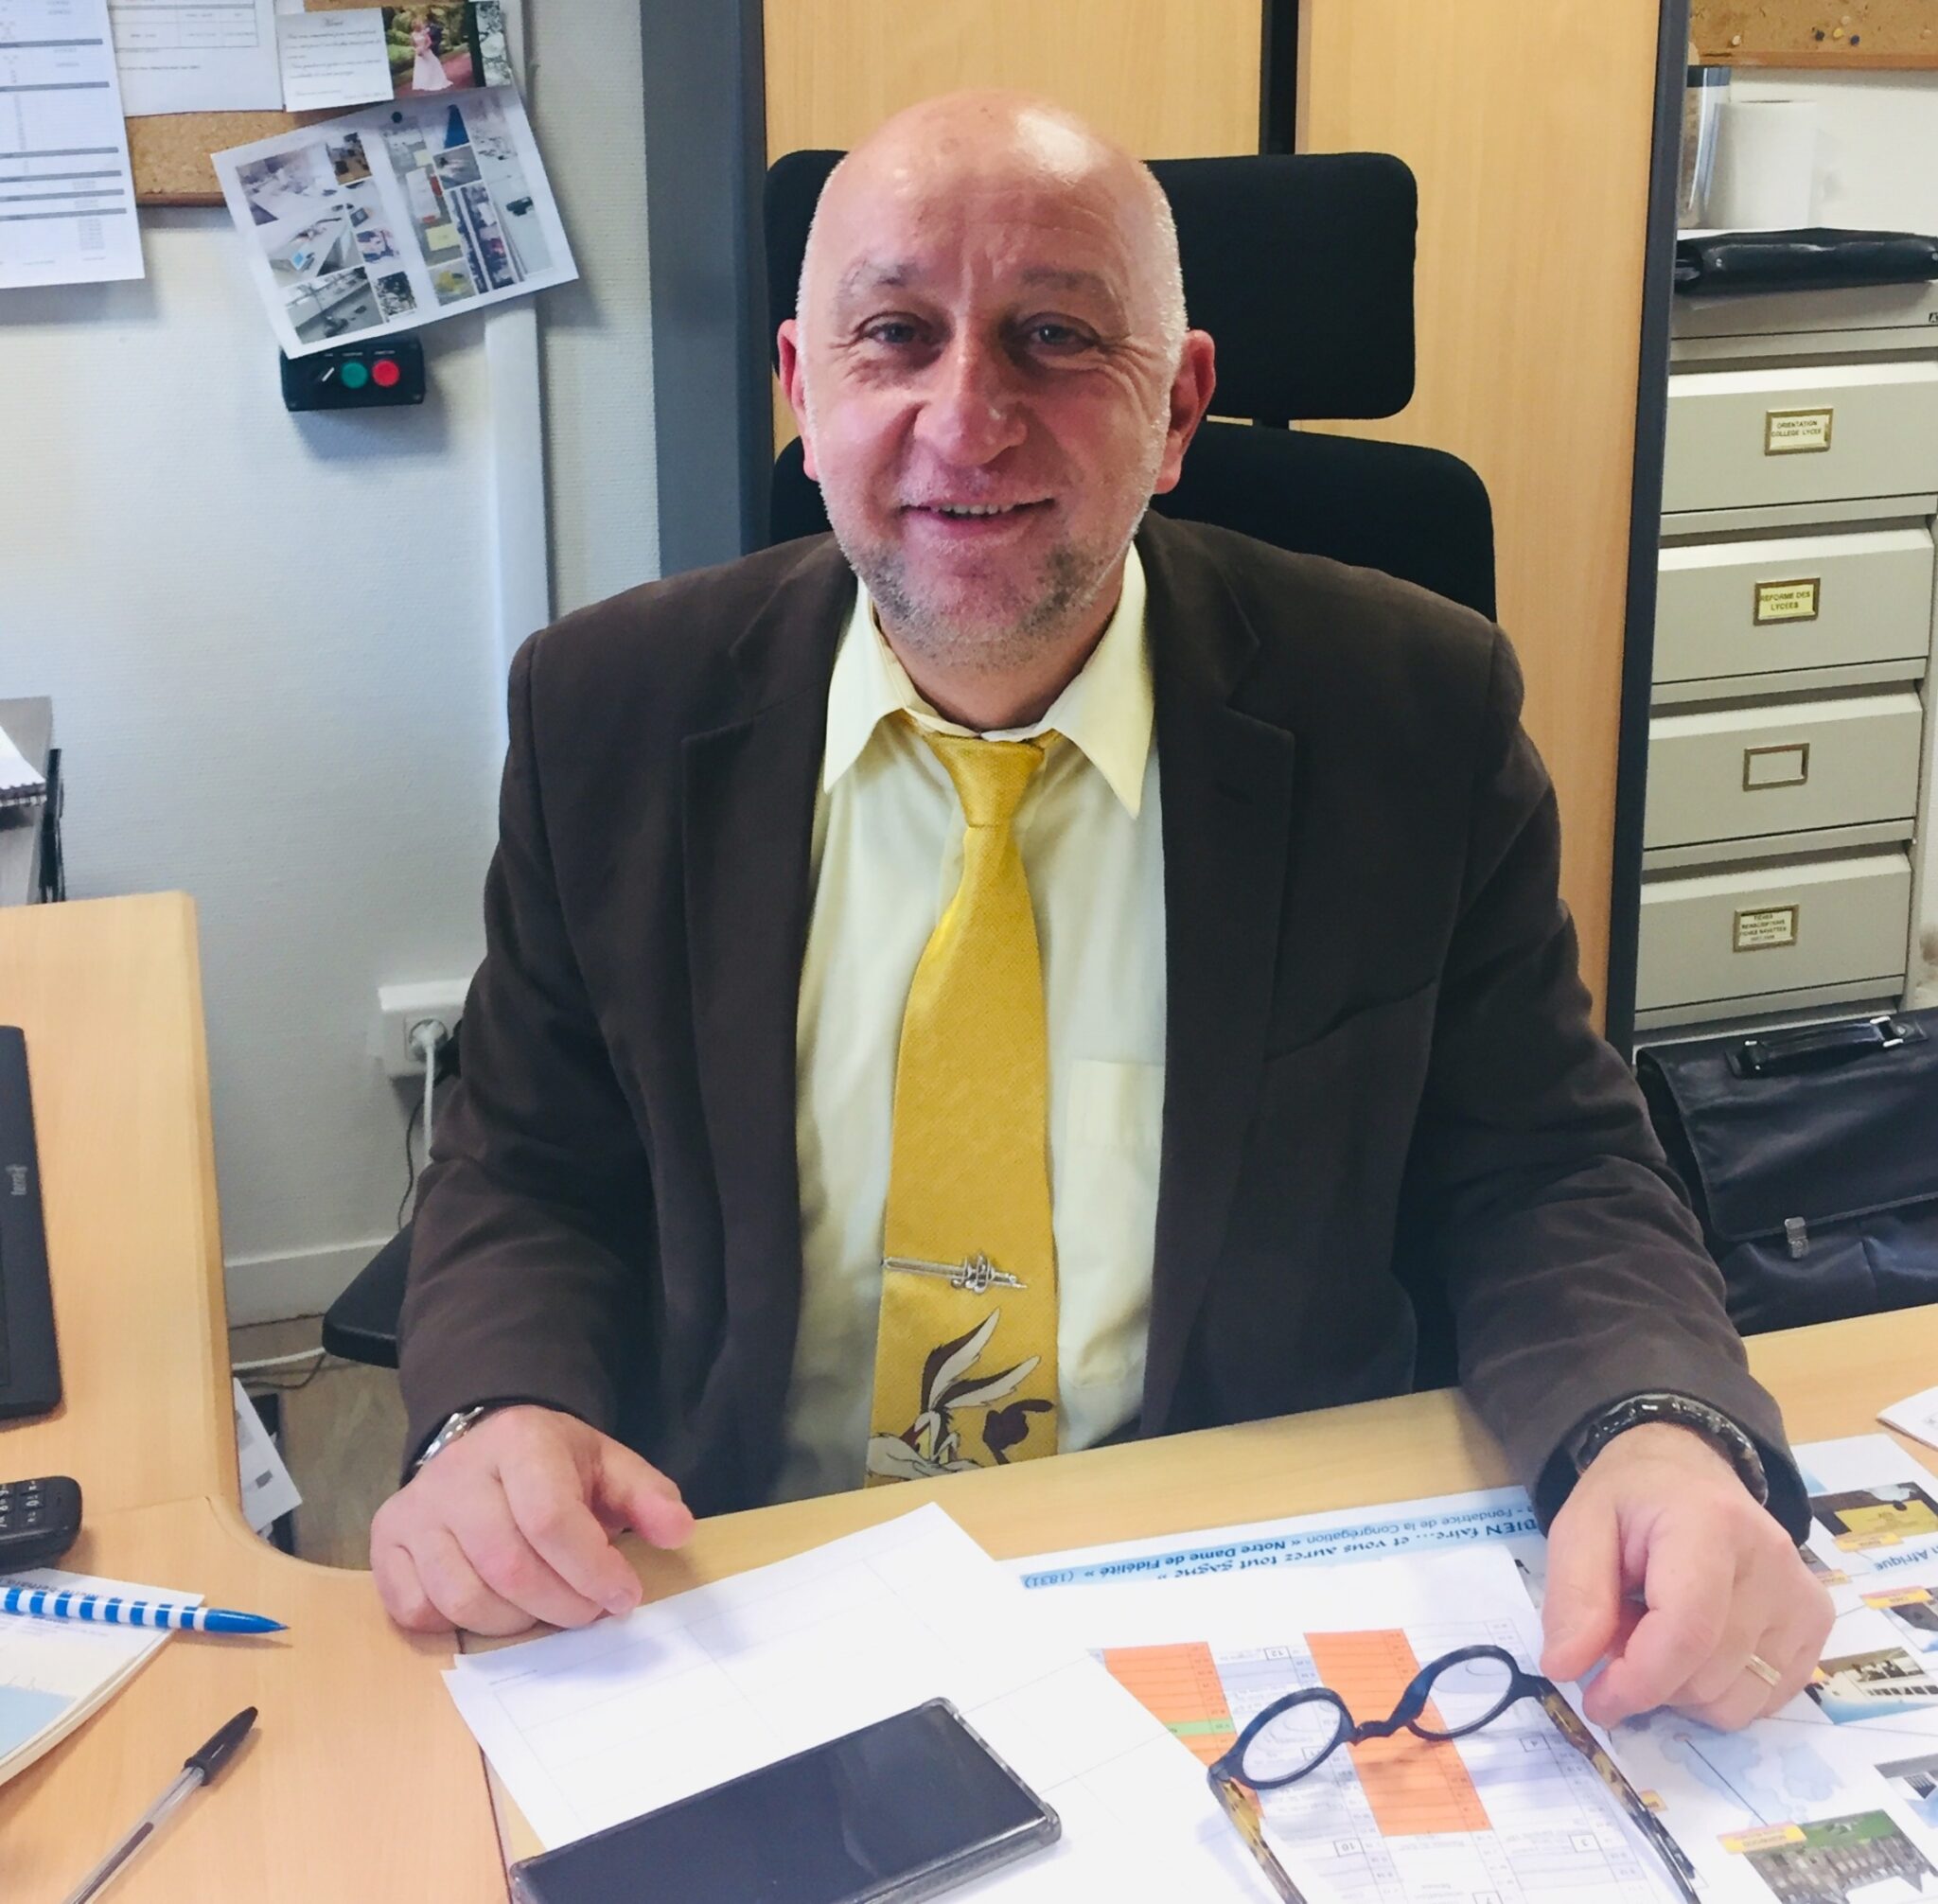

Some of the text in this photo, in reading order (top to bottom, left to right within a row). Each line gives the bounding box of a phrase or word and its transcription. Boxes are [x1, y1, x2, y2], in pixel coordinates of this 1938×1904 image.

[1777, 420, 1818, 430] ORIENTATION
[1760, 591, 1811, 602] REFORME DES
[1418, 1519, 1436, 1529] de
[1442, 1508, 1512, 1526] Fondatrice
[1403, 1521, 1416, 1531] la
[1306, 1525, 1400, 1546] Congrégation
[1393, 1536, 1409, 1547] et
[1242, 1541, 1285, 1556] Notre
[1343, 1540, 1386, 1554] vous
[1165, 1556, 1185, 1566] de
[1189, 1548, 1236, 1561] Dame
[1284, 1546, 1337, 1563] aurez
[1874, 1549, 1929, 1571] Afrique
[1100, 1559, 1160, 1577] Fidélité
[1240, 1556, 1277, 1570] tout
[1023, 1571, 1074, 1588] (1831)
